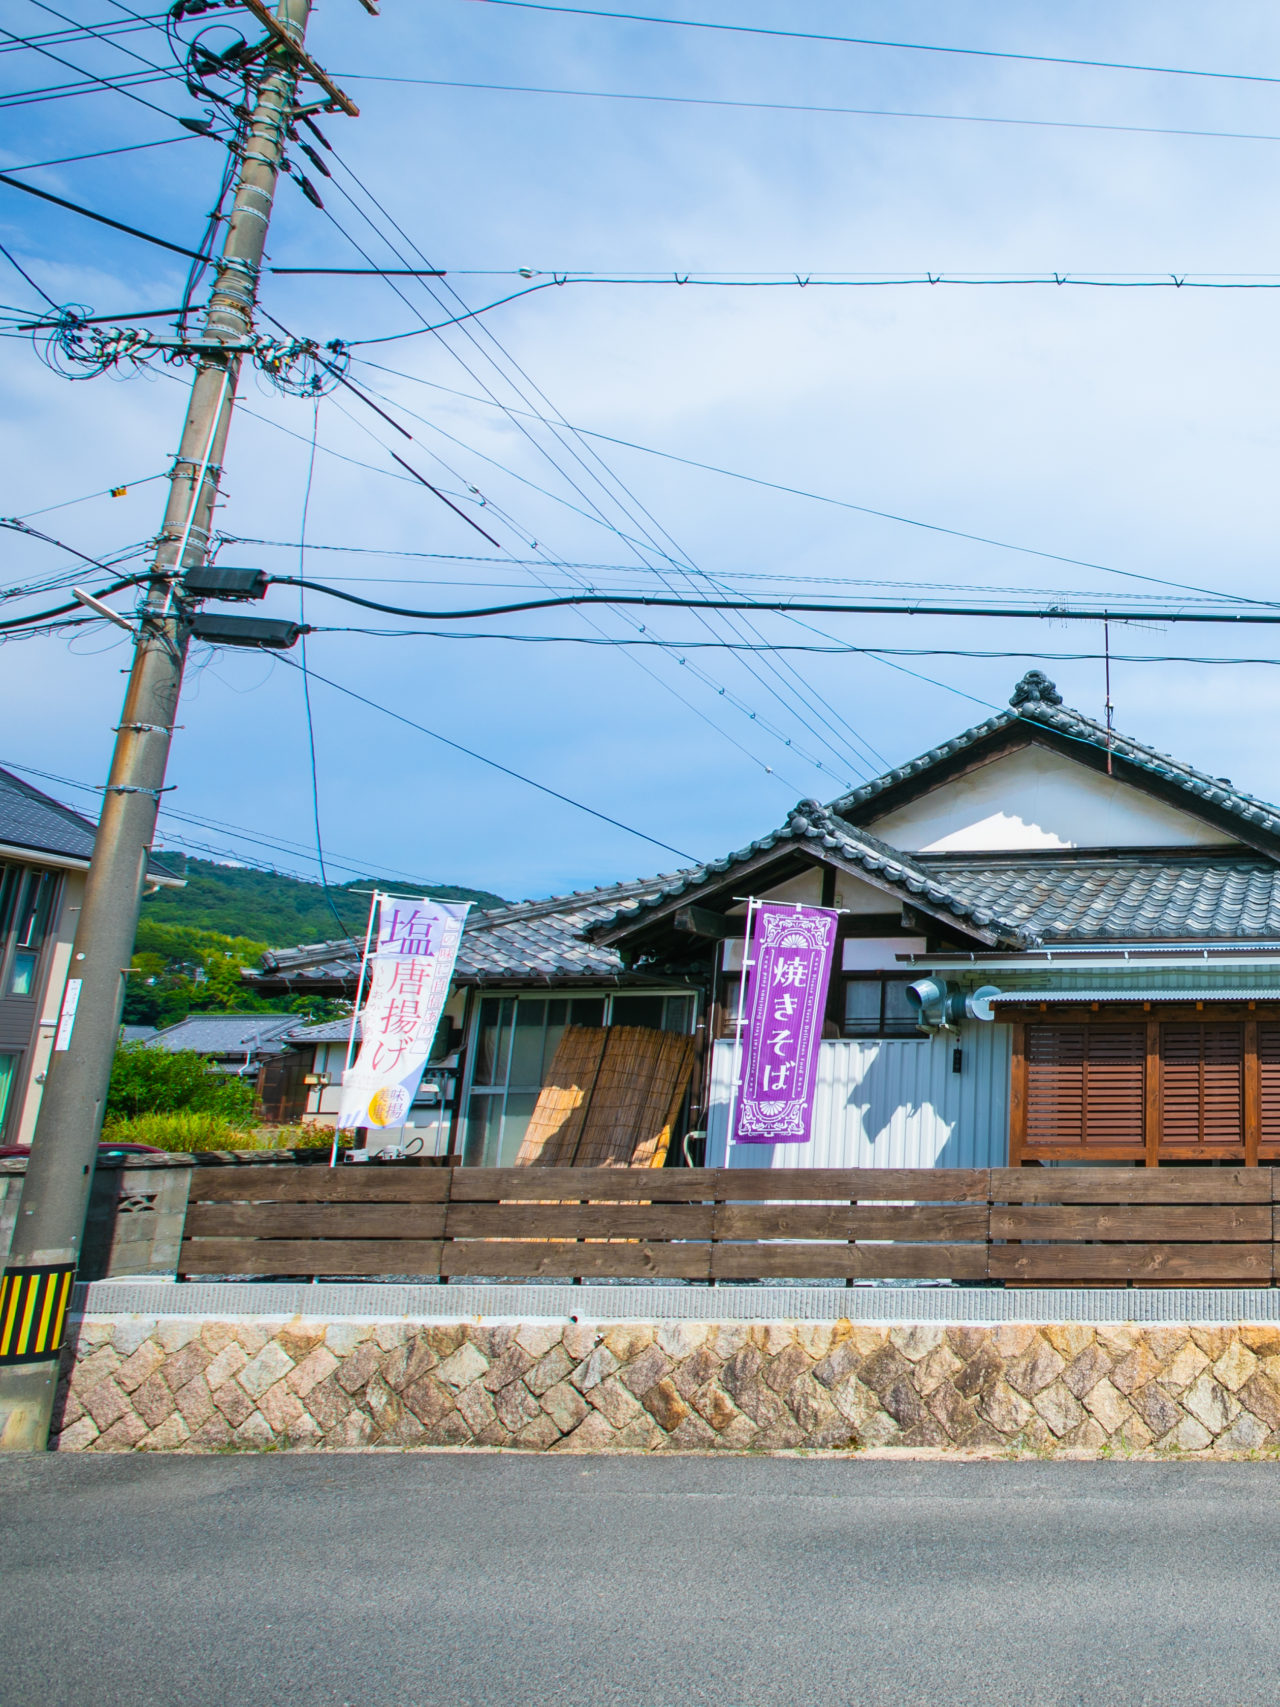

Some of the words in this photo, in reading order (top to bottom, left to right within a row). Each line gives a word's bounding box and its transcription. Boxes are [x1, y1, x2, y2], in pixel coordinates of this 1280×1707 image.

[372, 908, 440, 1074] 塩唐揚げ
[762, 956, 808, 1091] 焼きそば
[804, 1008, 812, 1023] Very
